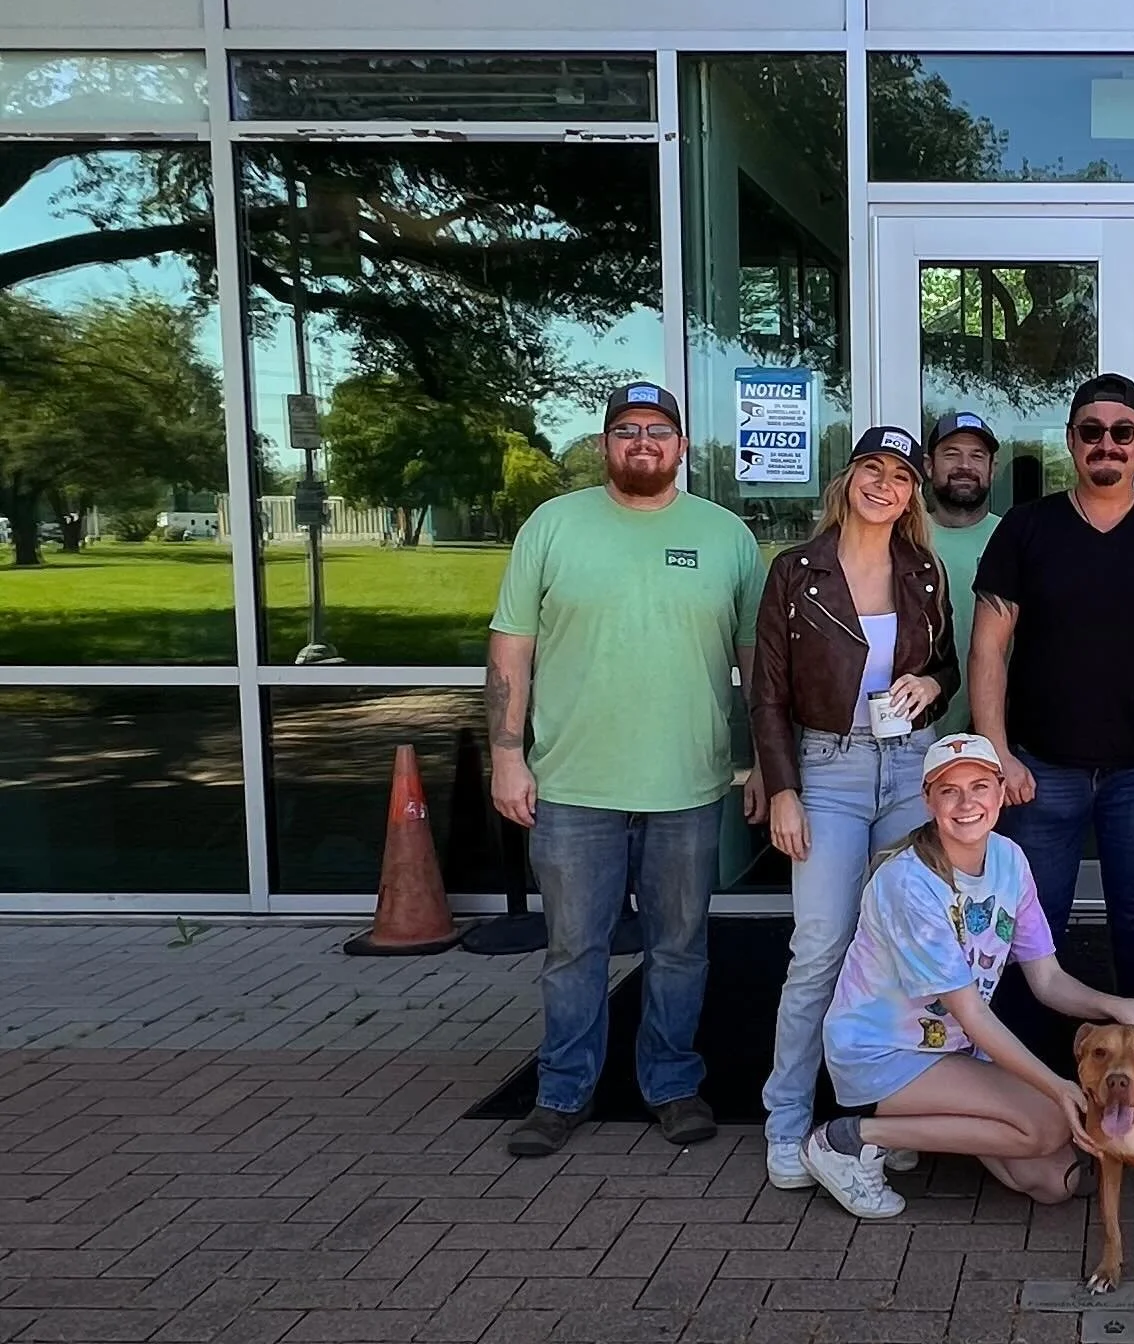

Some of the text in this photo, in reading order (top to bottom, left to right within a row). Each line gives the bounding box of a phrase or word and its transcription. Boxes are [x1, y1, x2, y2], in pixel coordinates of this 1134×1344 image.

[631, 393, 656, 401] POD
[745, 384, 802, 398] NOTICE
[746, 432, 800, 448] AVISO
[884, 438, 908, 453] POD
[668, 556, 696, 567] POD
